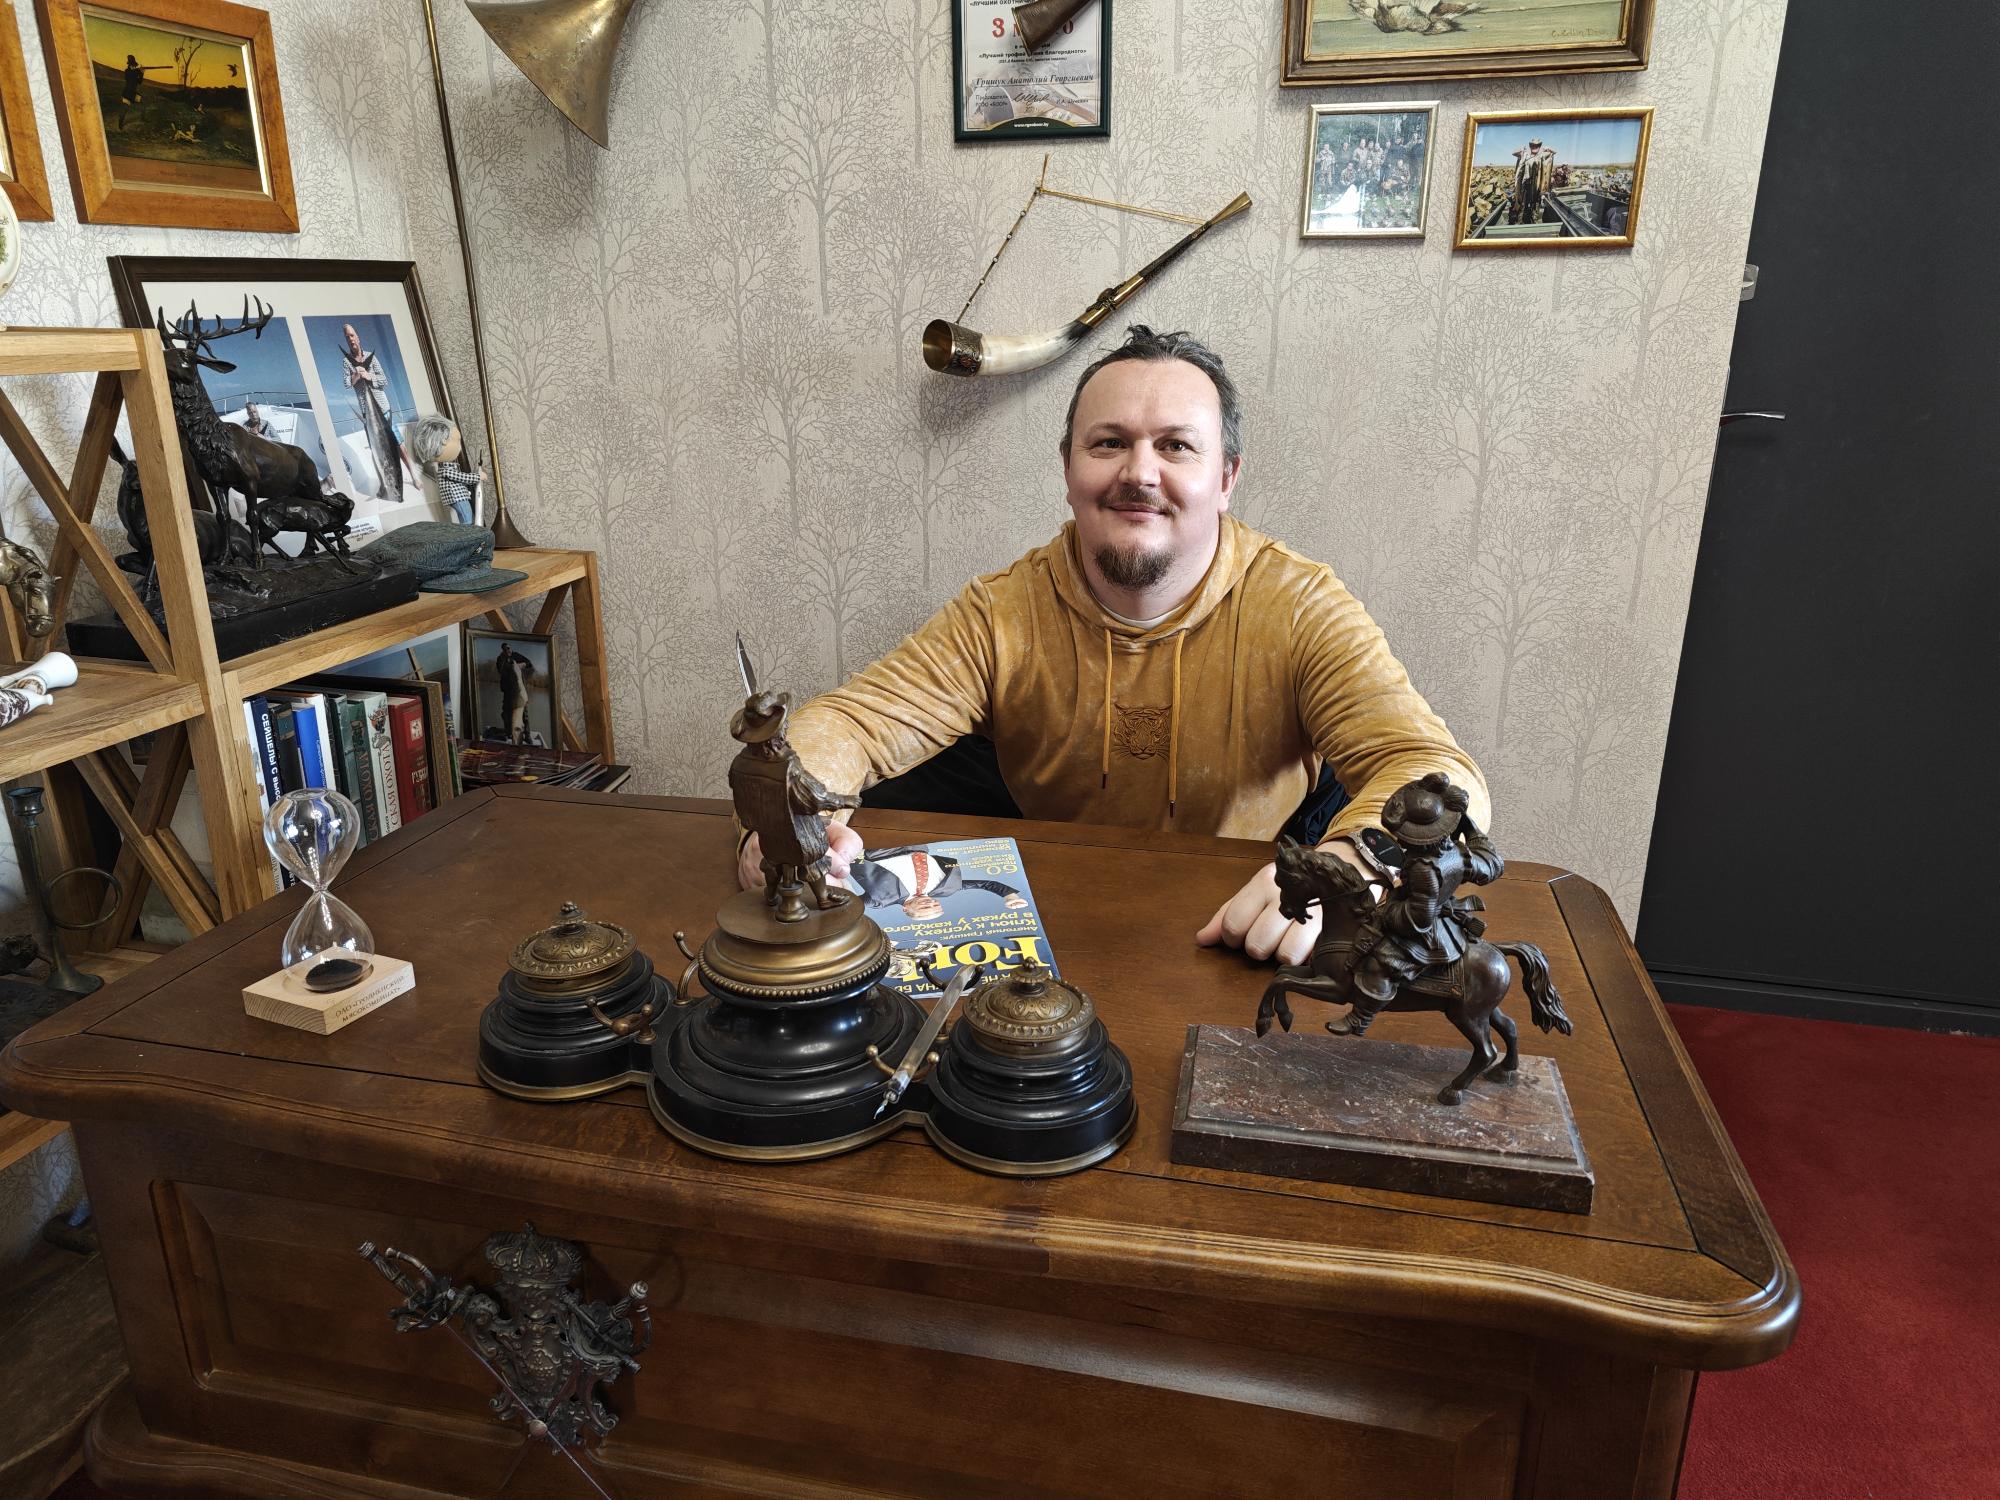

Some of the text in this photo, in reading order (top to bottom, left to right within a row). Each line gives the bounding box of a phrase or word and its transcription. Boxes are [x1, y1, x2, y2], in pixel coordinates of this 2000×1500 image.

[992, 18, 1005, 38] 3
[1007, 76, 1048, 85] Анатолий
[1050, 75, 1094, 84] Георгиевич
[261, 713, 276, 766] СЕЙШЕЛЫ
[380, 741, 395, 788] ОХОТА
[986, 864, 1018, 876] 60
[957, 917, 968, 925] у
[971, 911, 1019, 923] руках
[991, 918, 1037, 928] Ключ
[882, 920, 952, 934] каждого
[914, 924, 973, 937] успеху
[986, 925, 1038, 936] Анатолий
